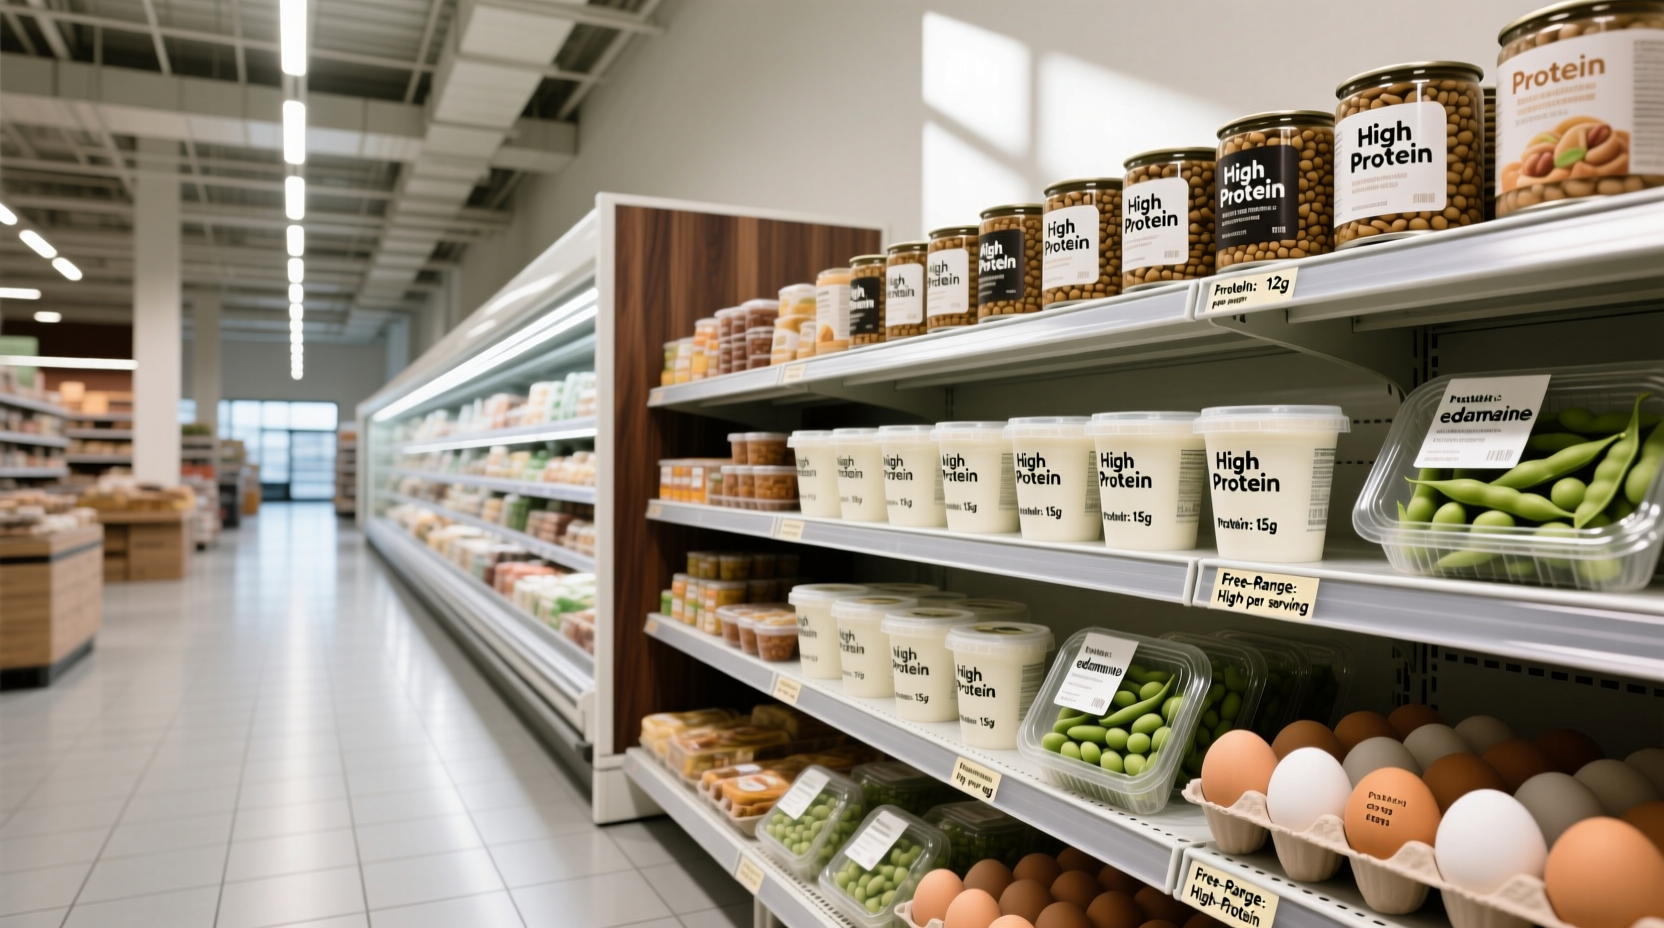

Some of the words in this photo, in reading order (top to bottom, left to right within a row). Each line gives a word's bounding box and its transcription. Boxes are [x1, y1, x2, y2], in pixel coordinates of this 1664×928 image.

[1512, 54, 1606, 95] Protein
[1357, 120, 1412, 148] High
[1351, 144, 1432, 173] Protein
[1224, 160, 1265, 186] High
[1220, 178, 1285, 208] Protein
[1128, 193, 1161, 216] High
[1125, 211, 1178, 234] Protein
[1045, 235, 1090, 256] Protein
[1266, 275, 1289, 294] 12g
[1016, 452, 1046, 472] High
[1101, 451, 1134, 473] High
[1216, 450, 1259, 475] High
[1100, 471, 1152, 488] Protein
[1213, 472, 1280, 493] Protein
[1046, 506, 1062, 520] 15g
[1133, 511, 1152, 527] 15g
[1256, 518, 1278, 535] 15g
[1221, 572, 1297, 595] Free-Range:
[1217, 590, 1244, 607] High
